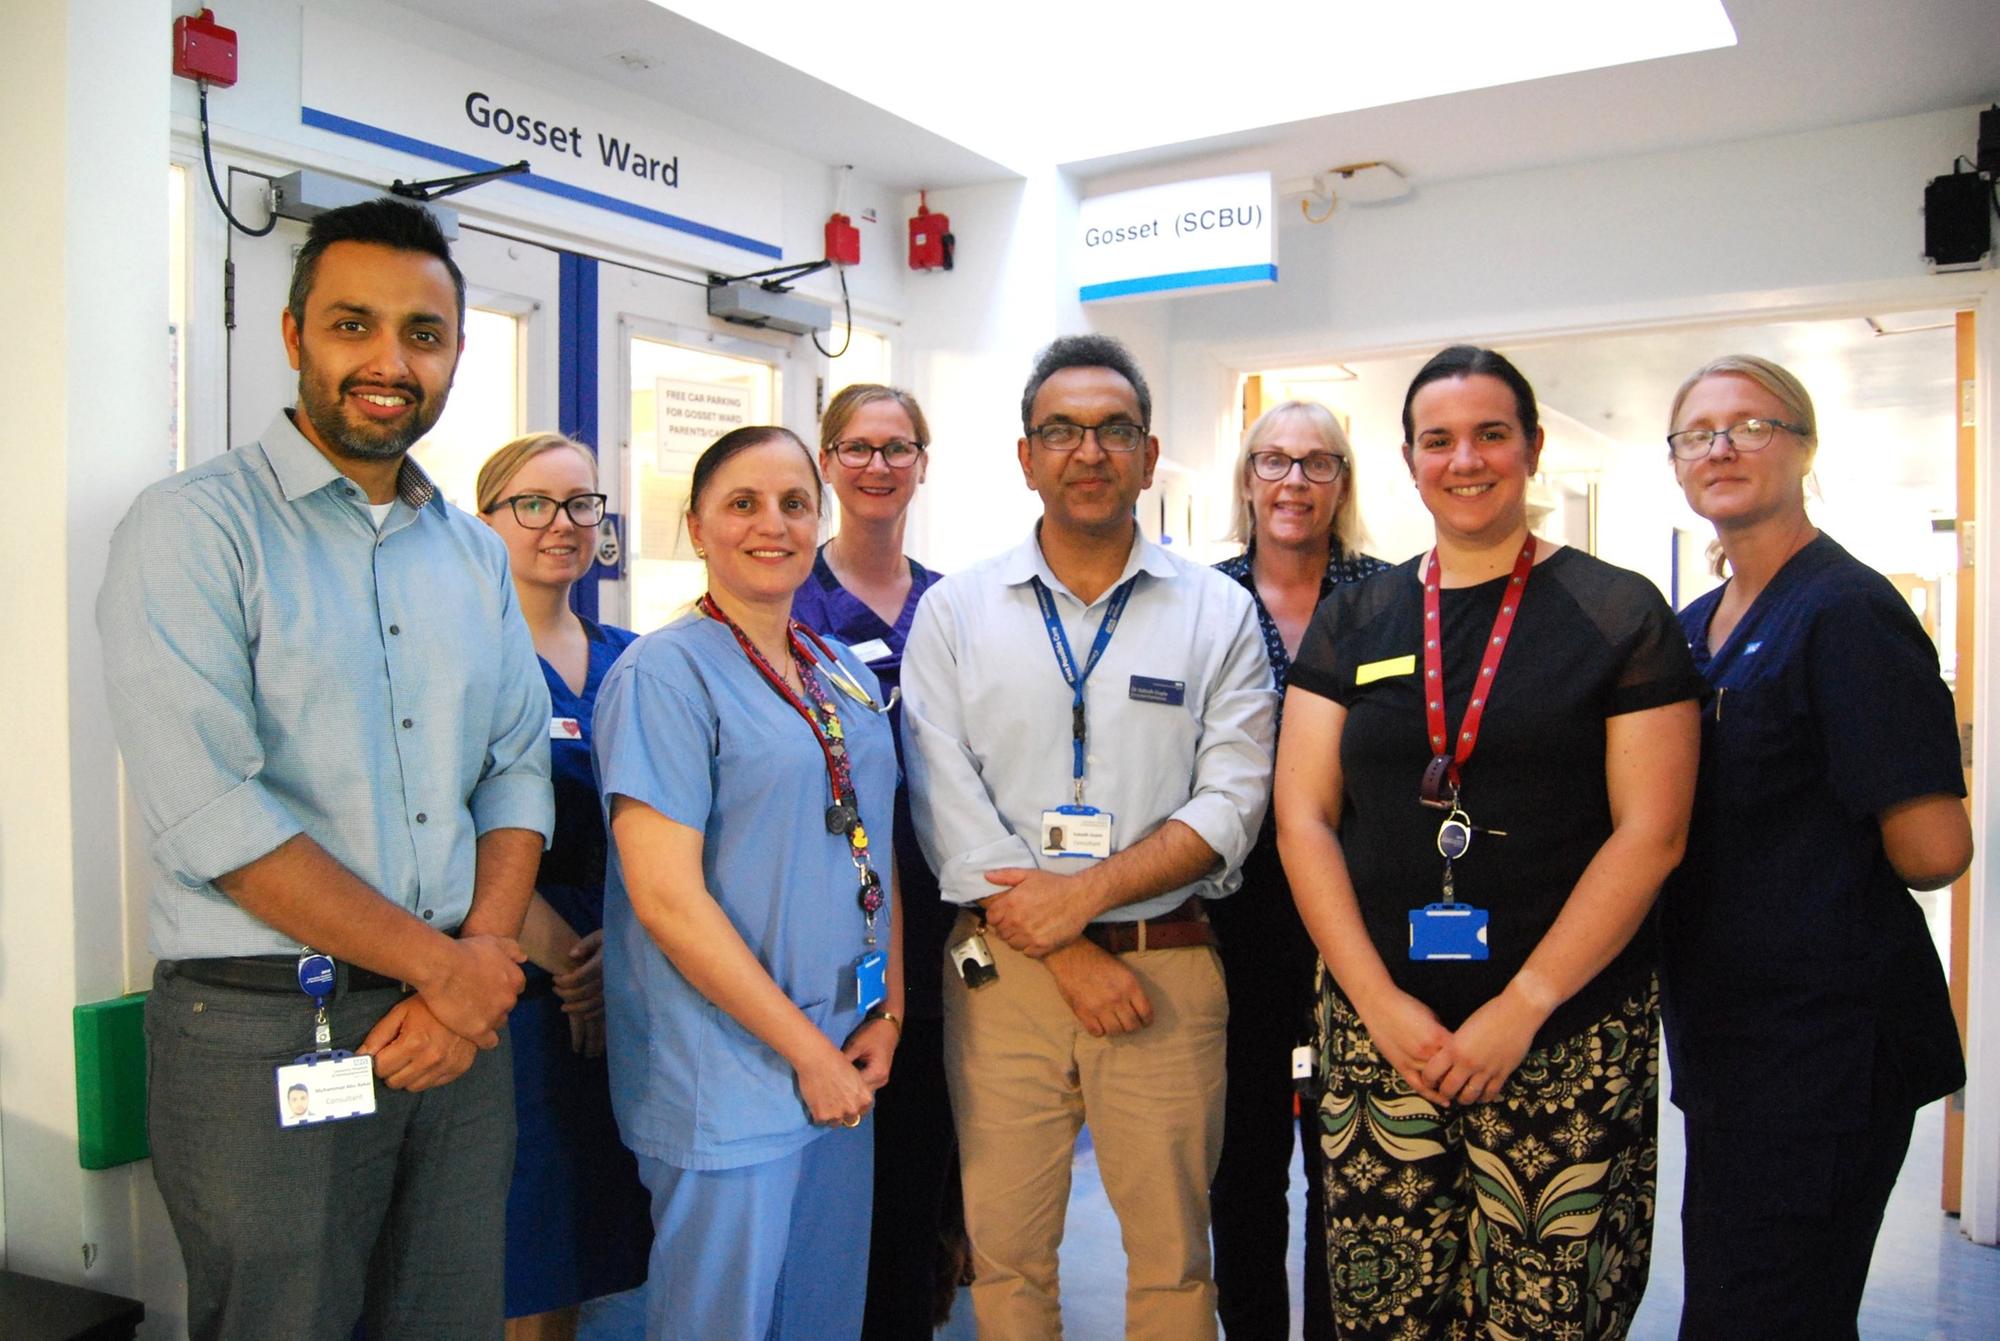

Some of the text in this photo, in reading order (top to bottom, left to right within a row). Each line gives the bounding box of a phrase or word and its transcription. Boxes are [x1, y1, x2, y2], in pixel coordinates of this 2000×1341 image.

[465, 91, 678, 188] Gosset Ward
[1085, 204, 1263, 248] Gosset (SCBU)
[665, 389, 742, 408] FREE CAR PARKING
[666, 406, 743, 424] FOR GOSSET WARD
